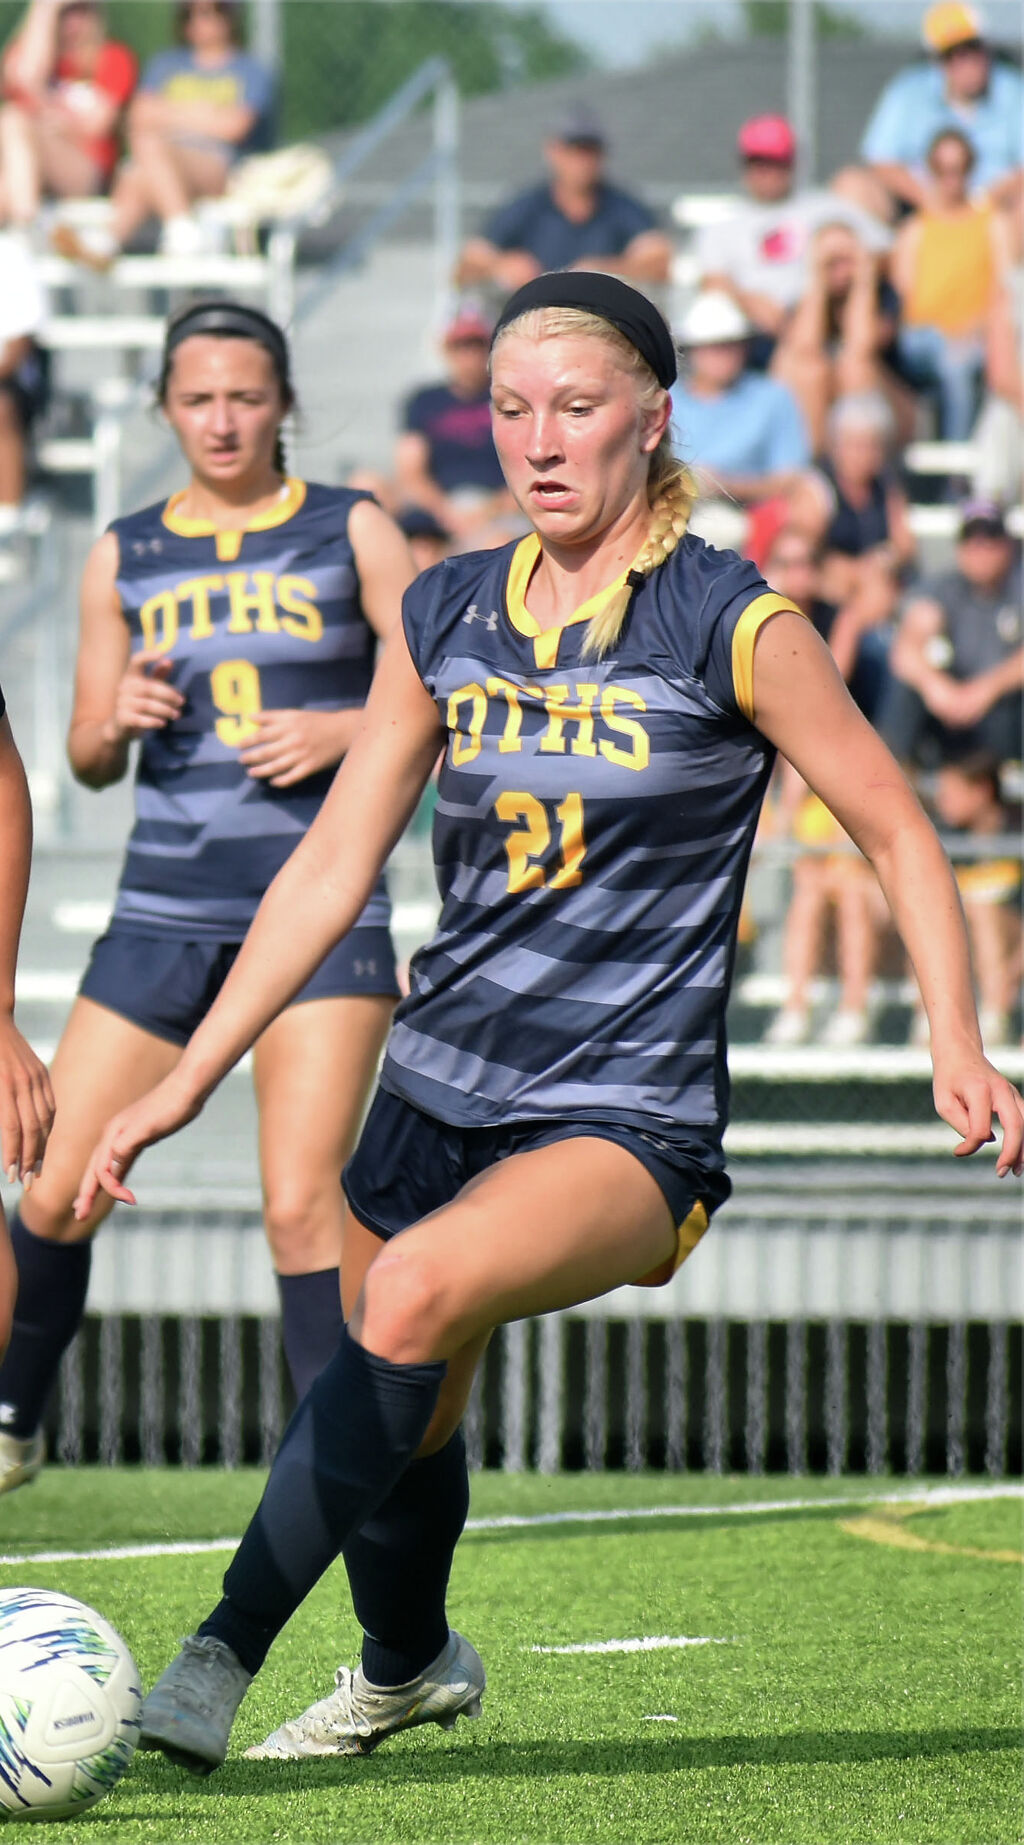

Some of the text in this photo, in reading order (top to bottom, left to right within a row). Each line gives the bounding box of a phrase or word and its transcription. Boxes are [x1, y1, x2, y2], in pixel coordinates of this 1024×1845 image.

[139, 571, 324, 653] OTHS
[210, 658, 262, 747] 9
[447, 677, 651, 771] OTHS
[495, 791, 588, 894] 21
